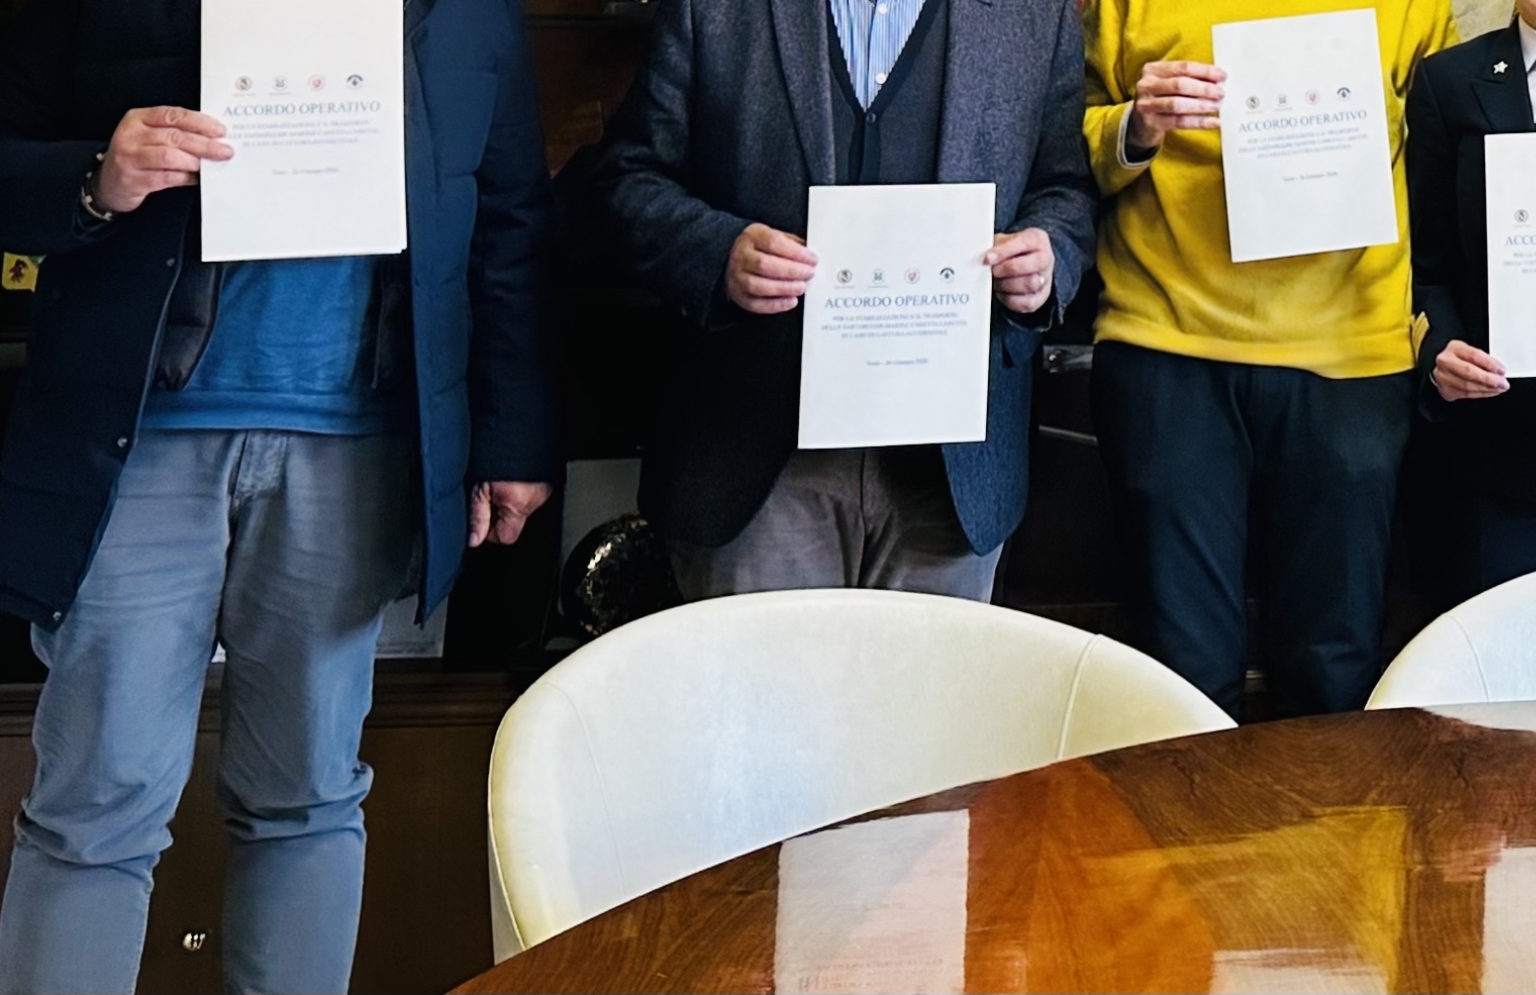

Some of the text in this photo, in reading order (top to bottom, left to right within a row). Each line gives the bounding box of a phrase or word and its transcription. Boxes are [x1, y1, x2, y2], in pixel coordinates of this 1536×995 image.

[223, 100, 381, 117] ACCORDO OPERATIVO
[1238, 117, 1298, 133] ACCORDO
[1300, 109, 1367, 126] OPERATIVO
[824, 293, 970, 309] ACCORDO OPERATIVO
